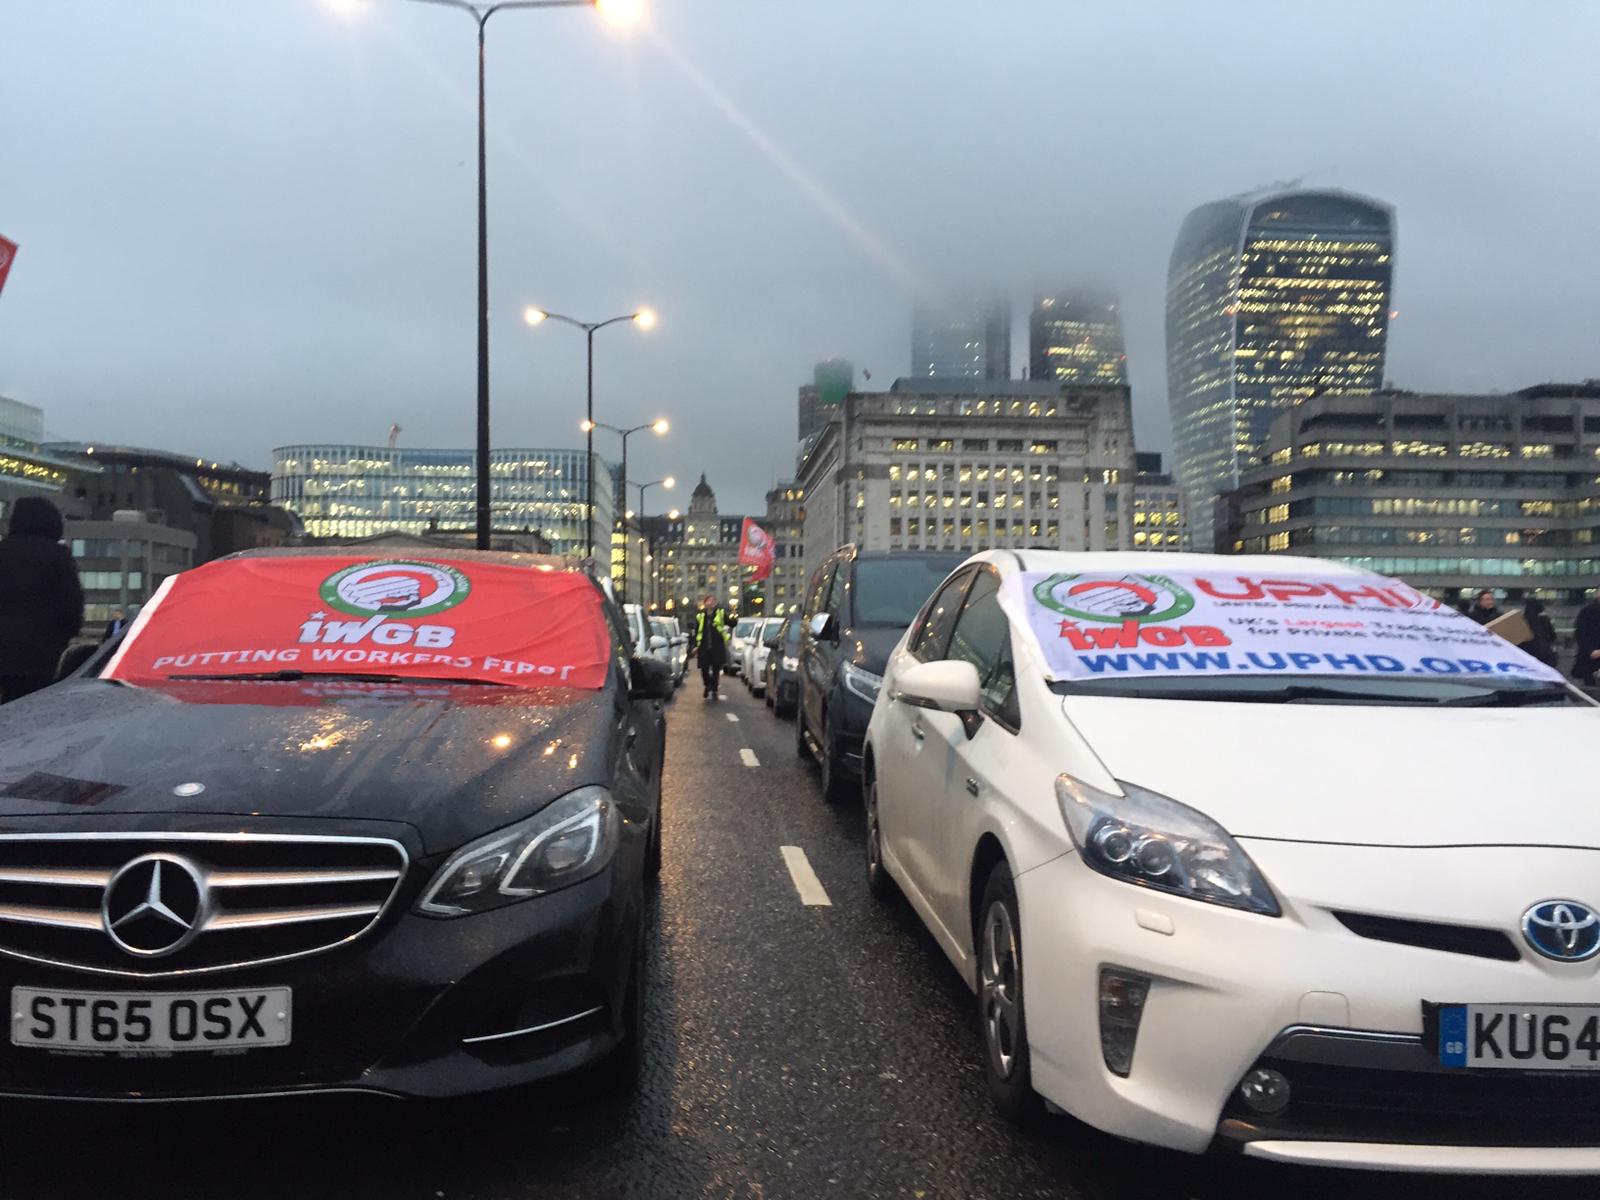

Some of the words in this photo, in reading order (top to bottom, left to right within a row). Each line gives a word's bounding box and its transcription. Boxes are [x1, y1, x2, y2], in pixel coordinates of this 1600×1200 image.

[152, 649, 301, 670] PUTTING
[31, 996, 152, 1042] ST65
[169, 995, 267, 1042] OSX
[1445, 1041, 1464, 1054] GB
[1474, 1012, 1600, 1061] KU64
